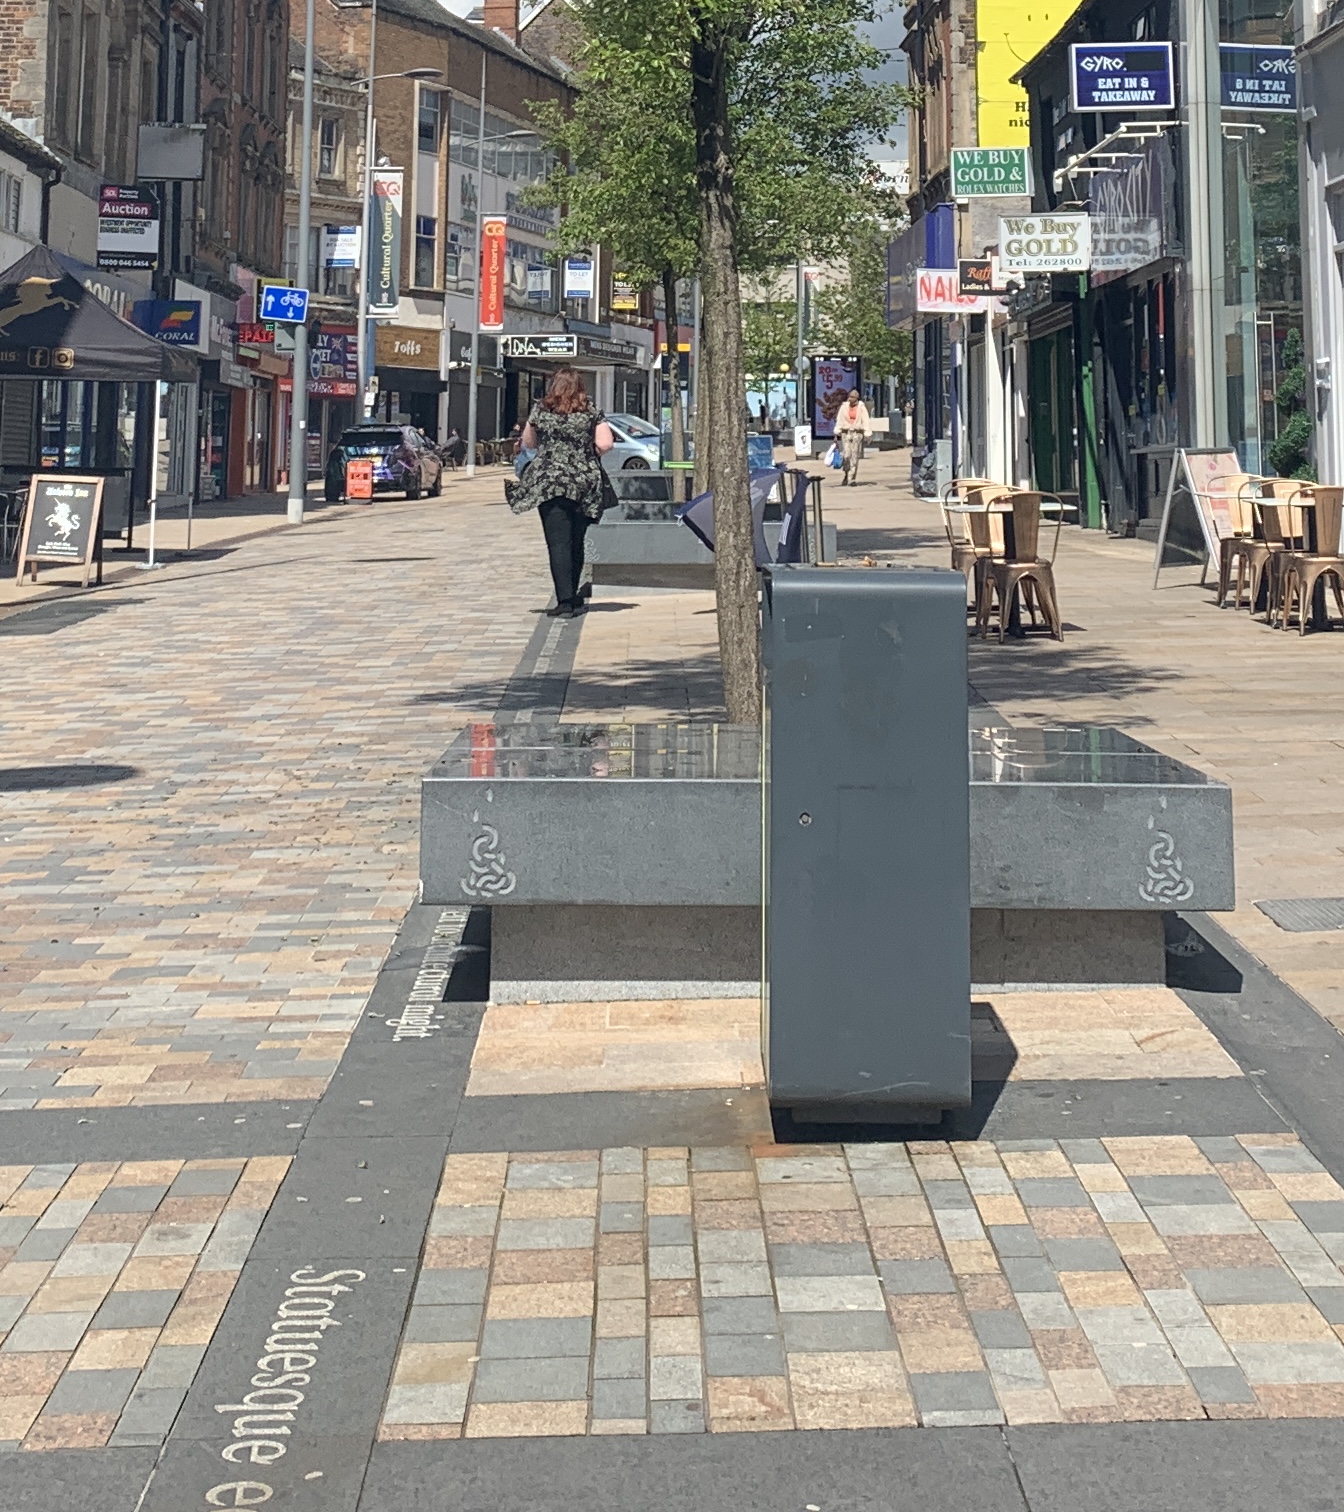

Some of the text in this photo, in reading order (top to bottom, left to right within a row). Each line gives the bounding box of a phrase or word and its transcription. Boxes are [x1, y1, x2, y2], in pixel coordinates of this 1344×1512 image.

[1097, 76, 1149, 89] EAT IN &
[1092, 90, 1156, 103] TAKEAWAY
[1015, 101, 1030, 113] H
[956, 150, 1023, 165] WE BUY
[957, 166, 1023, 182] GOLD &
[957, 183, 1025, 194] ROLEX WATCHES
[102, 202, 149, 216] Auction
[1004, 218, 1036, 236] We
[1040, 218, 1082, 239] Buy
[380, 199, 394, 289] Cultural Quarter
[1005, 239, 1079, 257] GOLD
[1006, 258, 1032, 267] Tel:
[1036, 257, 1082, 266] 262800
[488, 239, 500, 312] Cultural Quarter
[962, 282, 983, 291] Ladies
[154, 330, 196, 342] CORAL
[394, 340, 422, 356] Toffs
[214, 1267, 367, 1466] Statuesque
